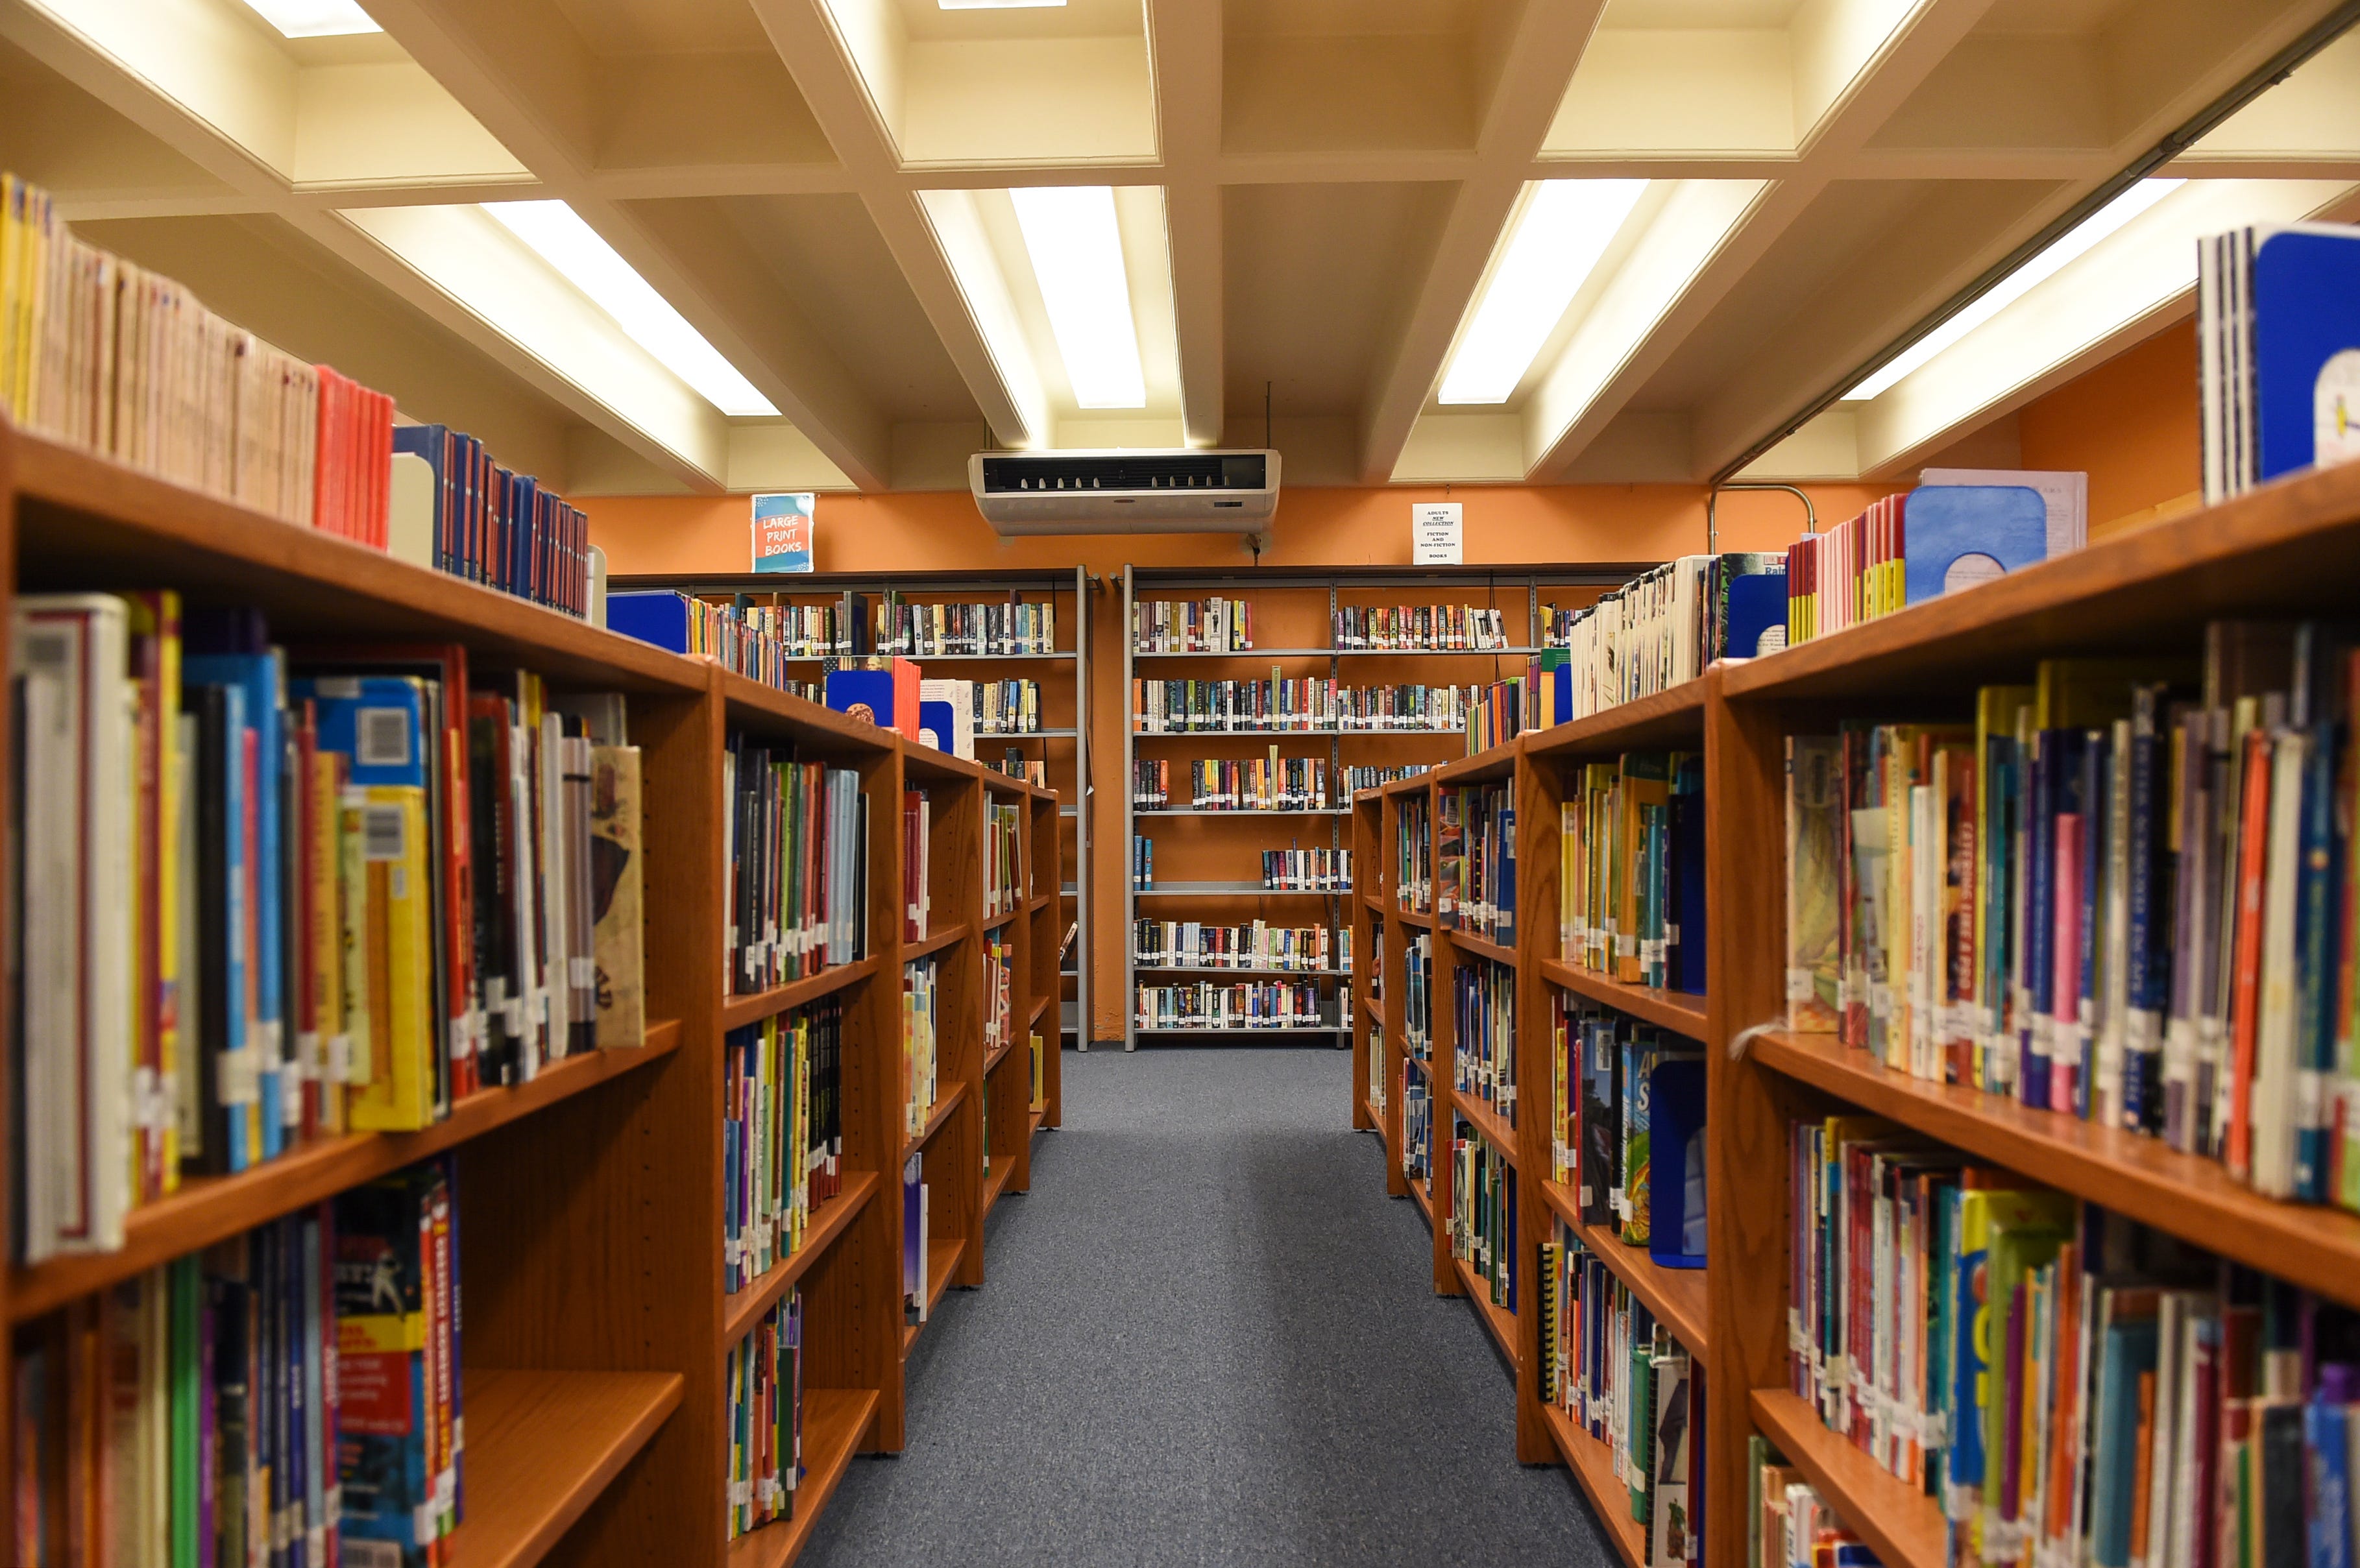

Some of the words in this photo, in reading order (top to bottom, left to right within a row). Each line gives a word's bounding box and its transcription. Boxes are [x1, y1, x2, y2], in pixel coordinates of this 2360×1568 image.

[763, 515, 798, 529] LARGE
[766, 529, 797, 543] PRINT
[765, 542, 802, 557] BOOKS
